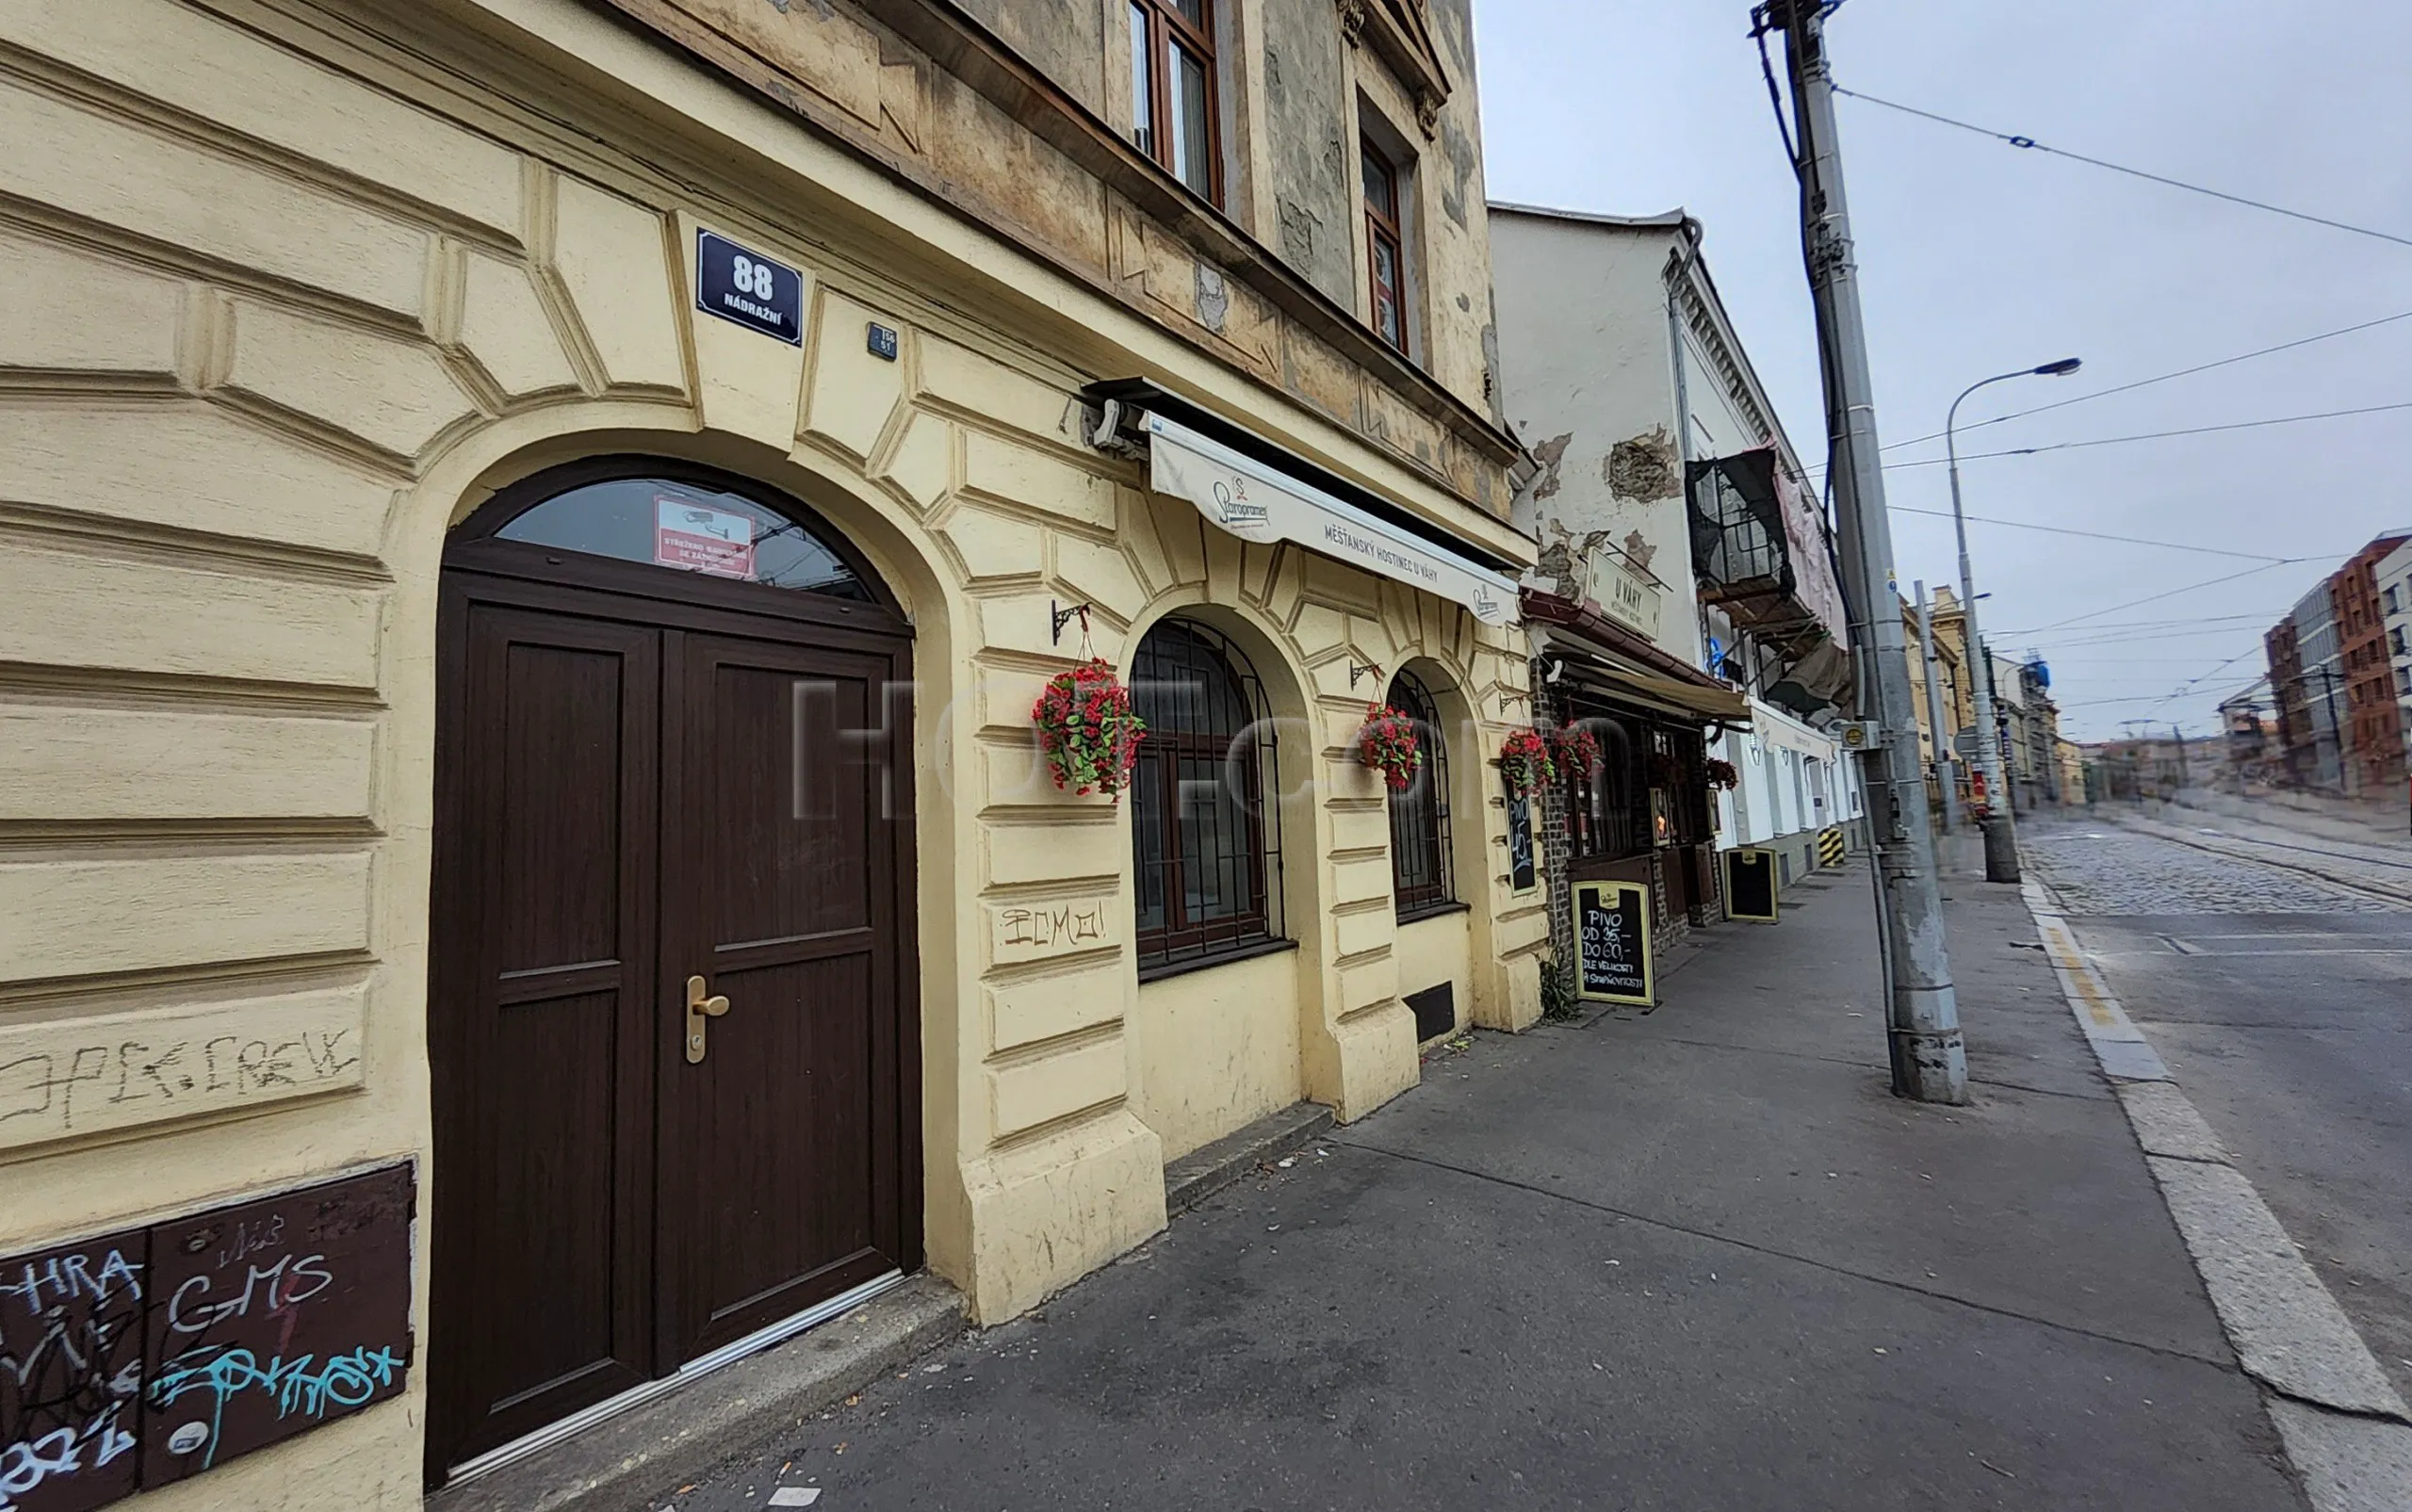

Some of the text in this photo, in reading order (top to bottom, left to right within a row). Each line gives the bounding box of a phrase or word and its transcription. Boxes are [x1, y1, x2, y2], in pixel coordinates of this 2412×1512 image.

[733, 255, 773, 301] 88
[725, 293, 782, 325] NÁDRAŽNÍ
[1325, 524, 1375, 557] MĚŠŤANSKÝ
[1377, 546, 1412, 573] HOSTINEC
[1414, 561, 1420, 576] U
[1615, 577, 1642, 612] U VÁHY
[1508, 798, 1529, 821] PIVO
[1588, 910, 1622, 926] PIVO
[1581, 926, 1600, 941] OD
[1583, 941, 1601, 957] DO
[1583, 958, 1597, 970] DLE
